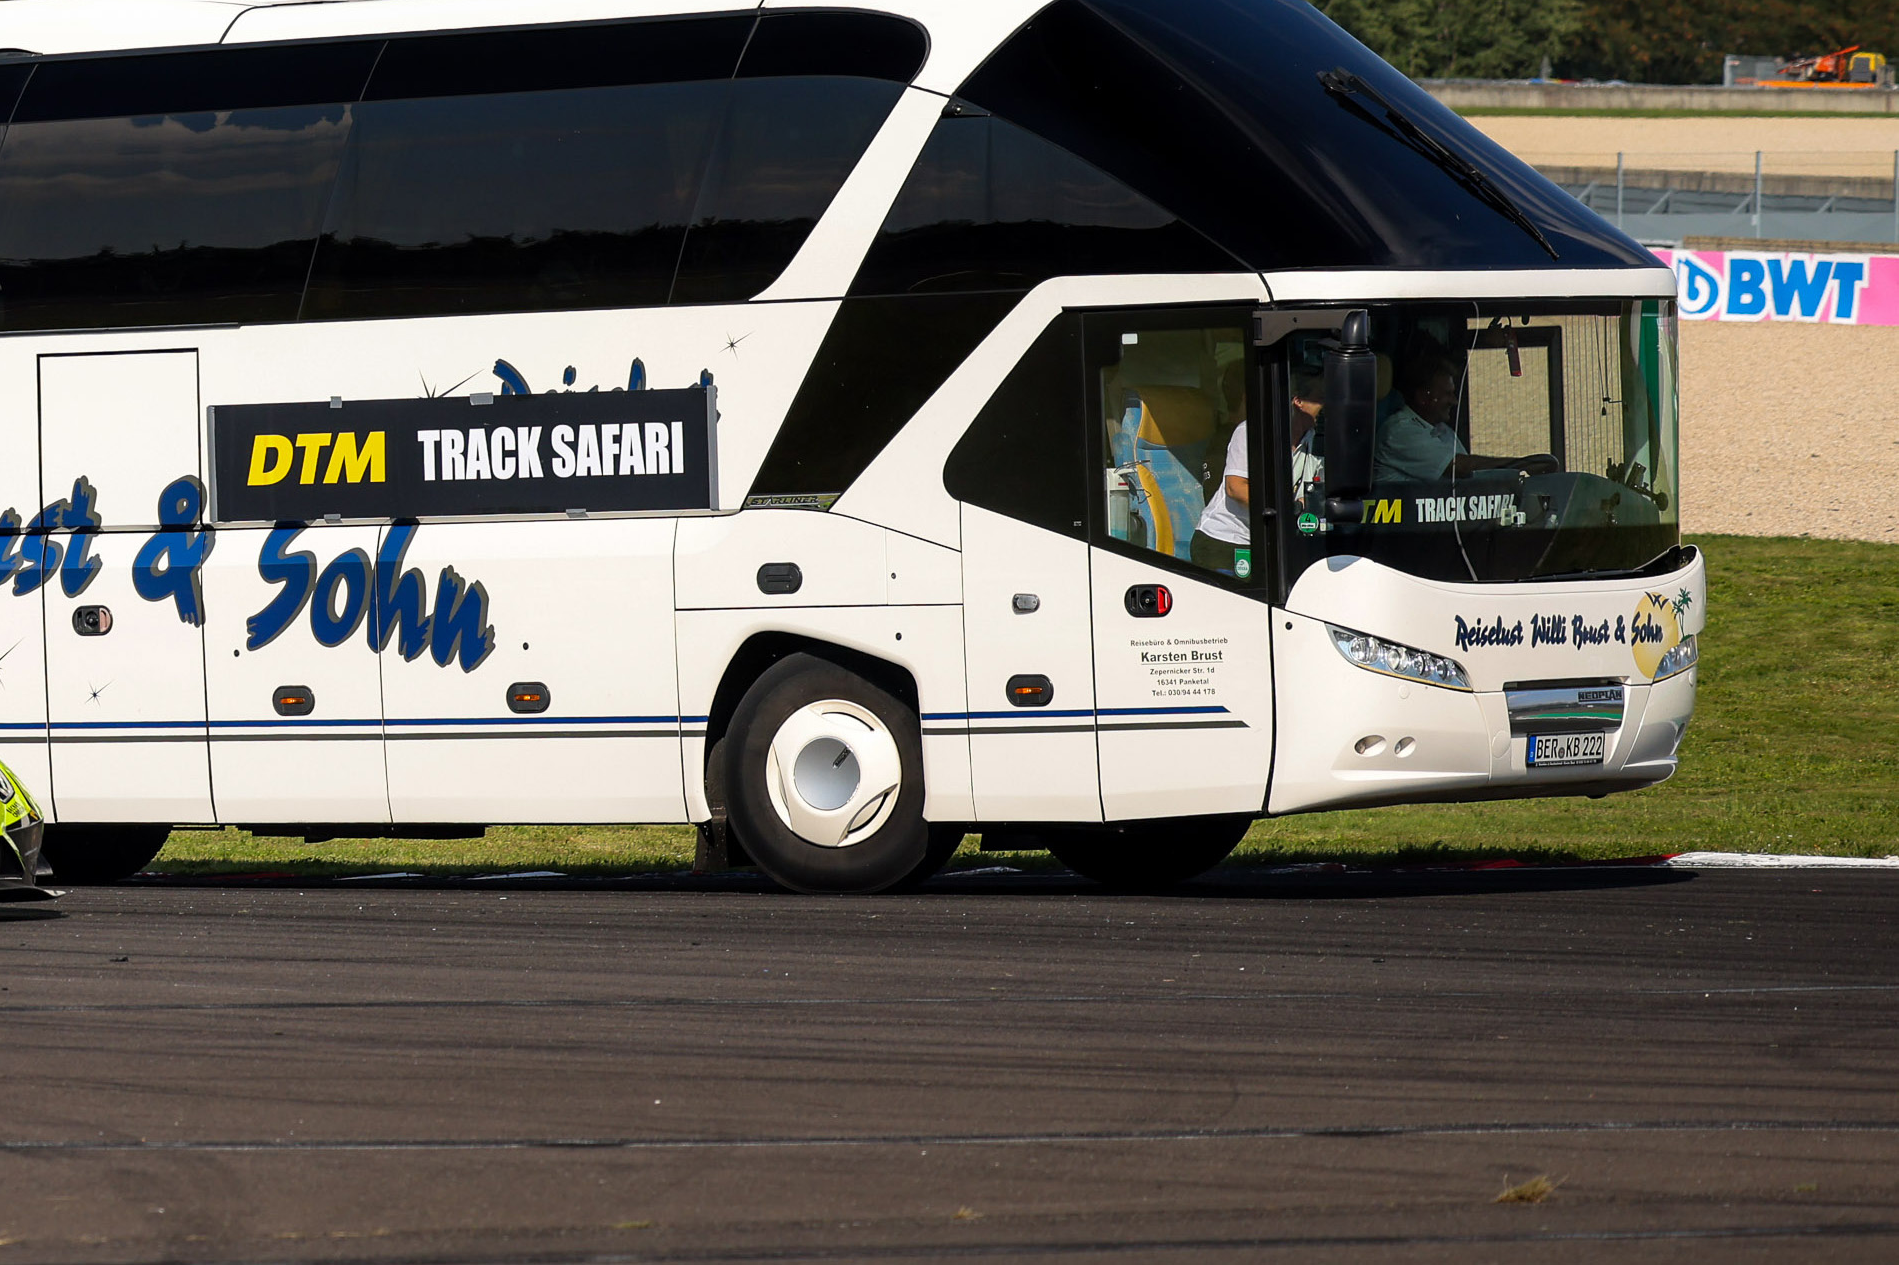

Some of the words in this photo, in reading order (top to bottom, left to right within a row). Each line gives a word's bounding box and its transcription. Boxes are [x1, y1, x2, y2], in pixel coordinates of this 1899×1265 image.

[1726, 258, 1864, 319] BWT
[247, 431, 387, 487] DTM
[417, 426, 546, 482] TRACK
[552, 420, 685, 478] SAFARI
[751, 496, 820, 505] STARLINER
[1361, 498, 1402, 524] TM
[1416, 497, 1467, 523] TRACK
[132, 474, 215, 629] &
[246, 517, 497, 674] Sohn
[1454, 614, 1524, 652] Reiselust
[1530, 613, 1567, 648] Willi
[1571, 614, 1610, 650] Brust
[1614, 615, 1626, 644] &
[1631, 611, 1663, 647] Sohn
[1141, 652, 1187, 662] Karsten
[1191, 650, 1223, 661] Brust
[1150, 668, 1191, 676] Zepernicker
[1578, 689, 1623, 702] NEOPLAN
[1536, 738, 1559, 759] BER
[1566, 737, 1581, 757] KB
[1583, 736, 1603, 756] 222
